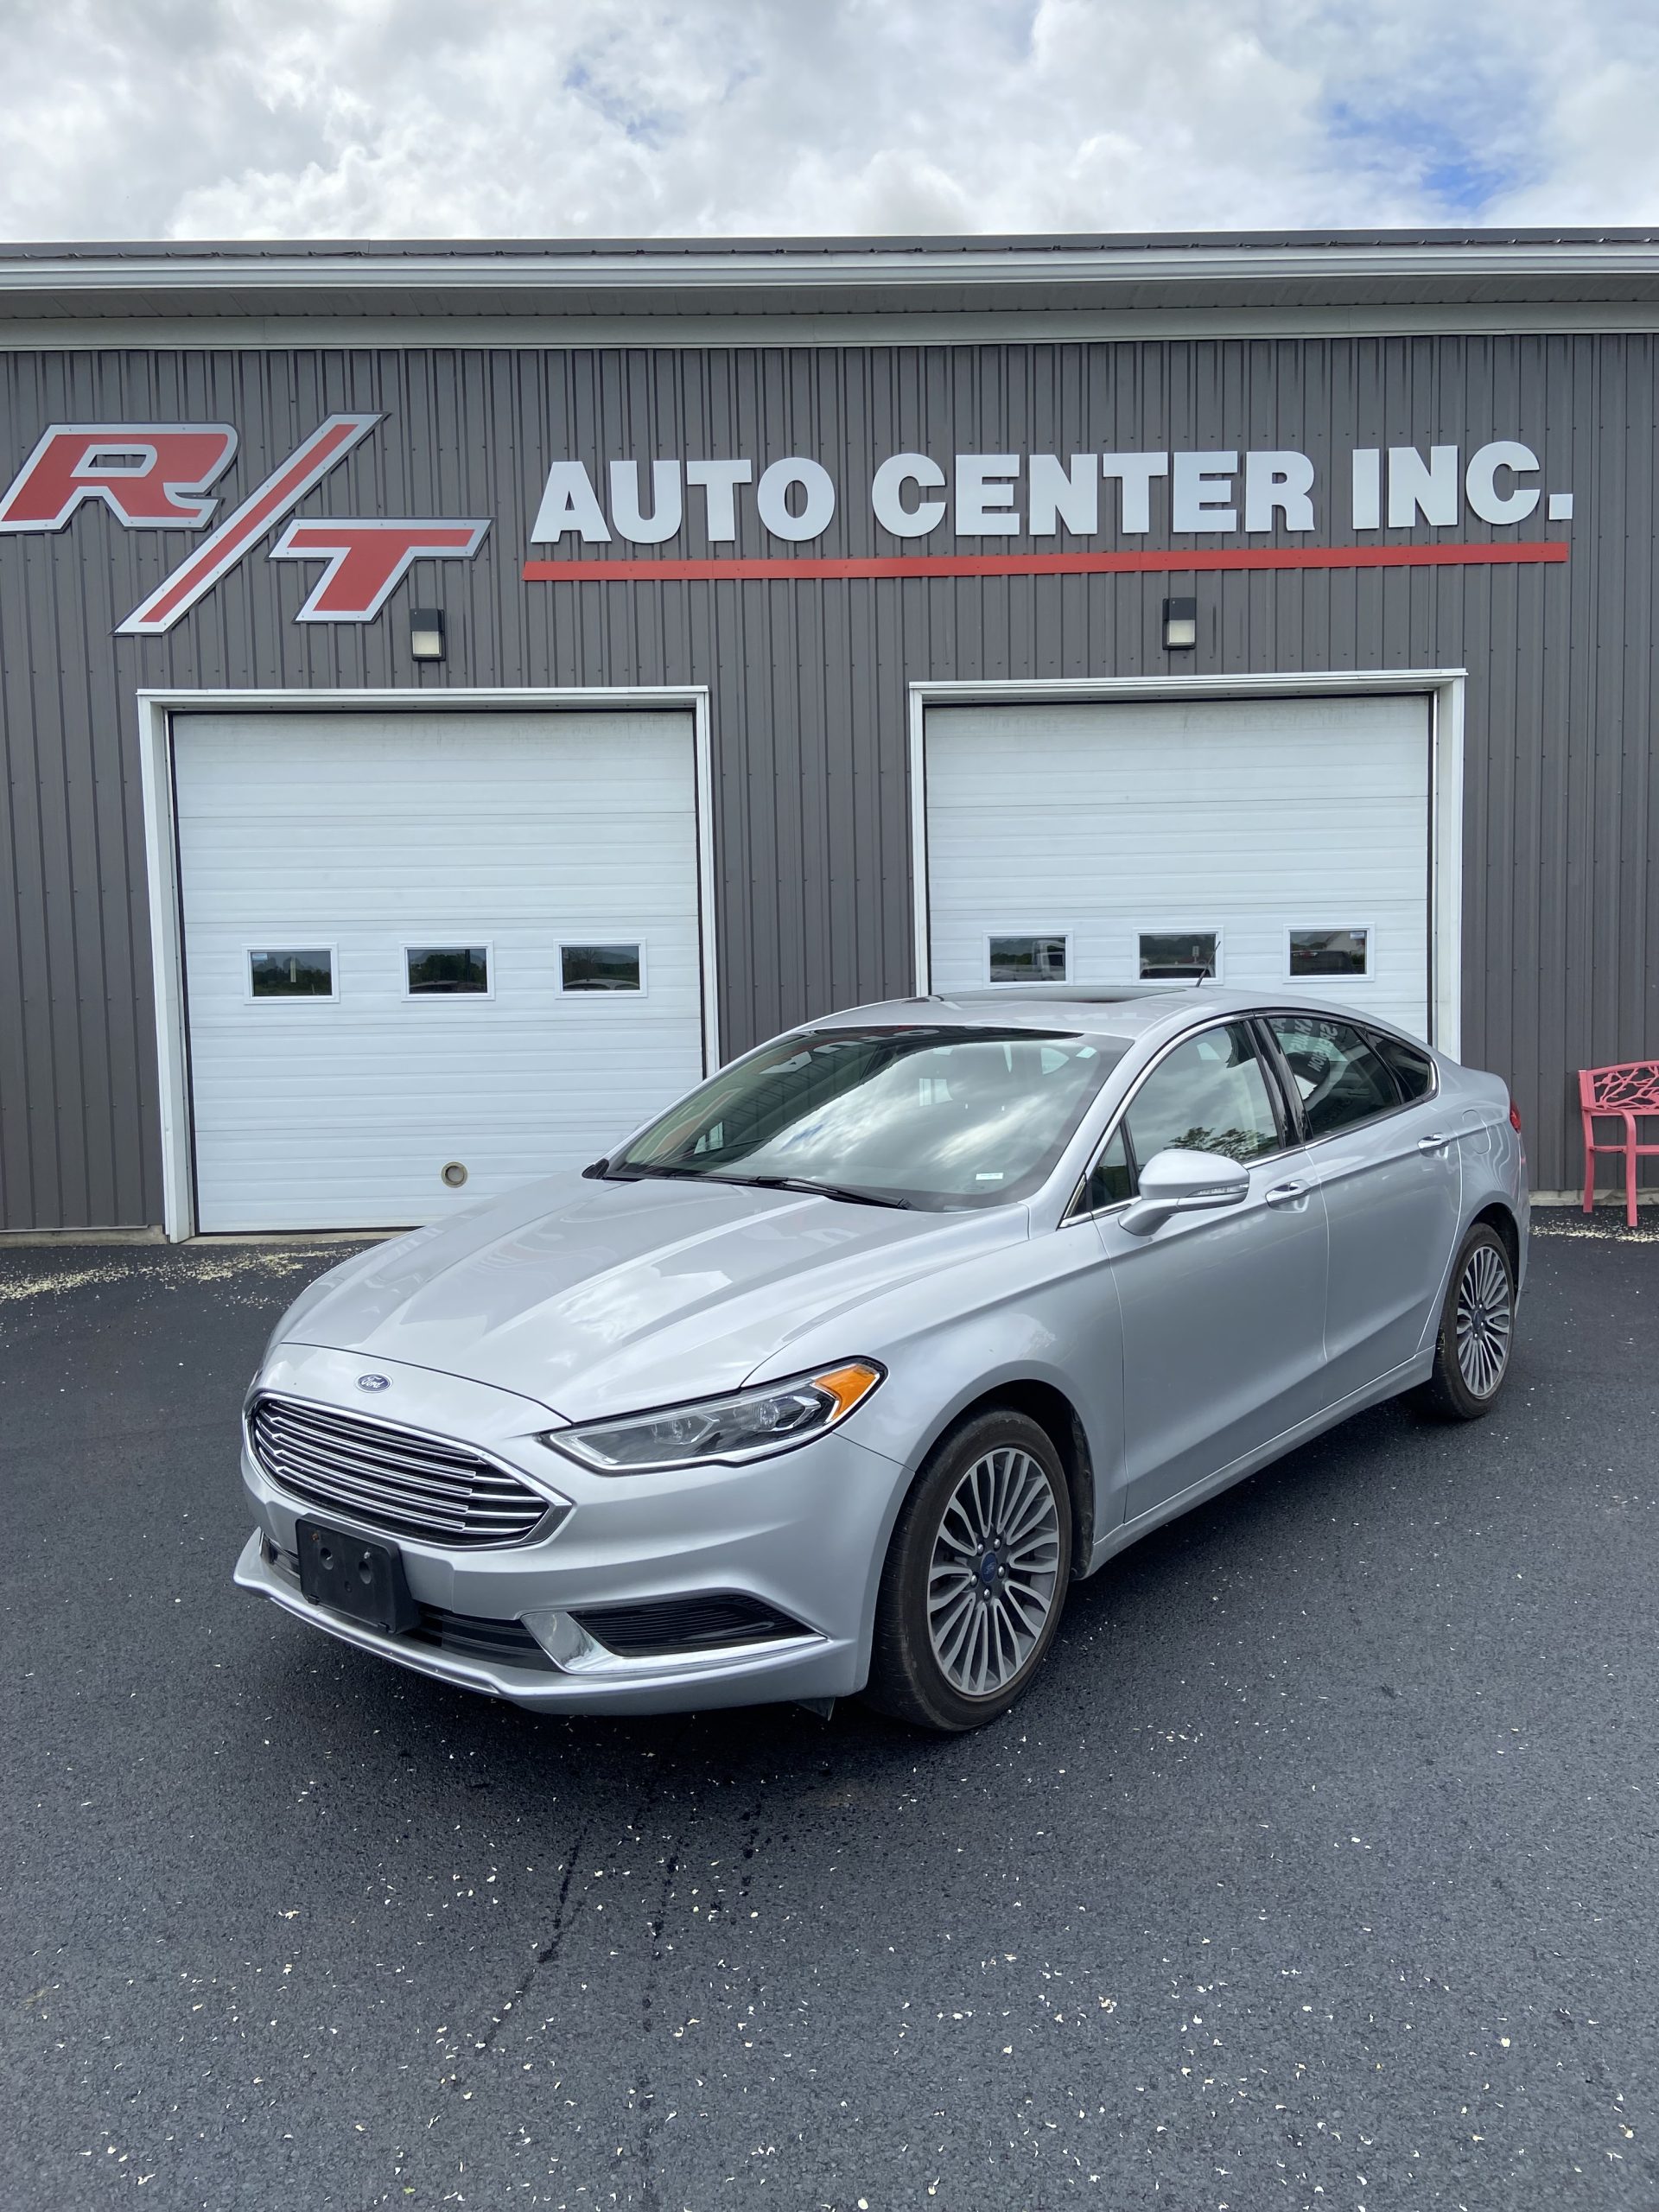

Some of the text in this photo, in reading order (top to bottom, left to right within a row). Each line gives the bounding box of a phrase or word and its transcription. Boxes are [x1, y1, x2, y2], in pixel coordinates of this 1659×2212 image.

[0, 412, 494, 636] R/T
[531, 441, 1573, 543] AUTO CENTER INC.
[361, 1376, 385, 1389] Ford
